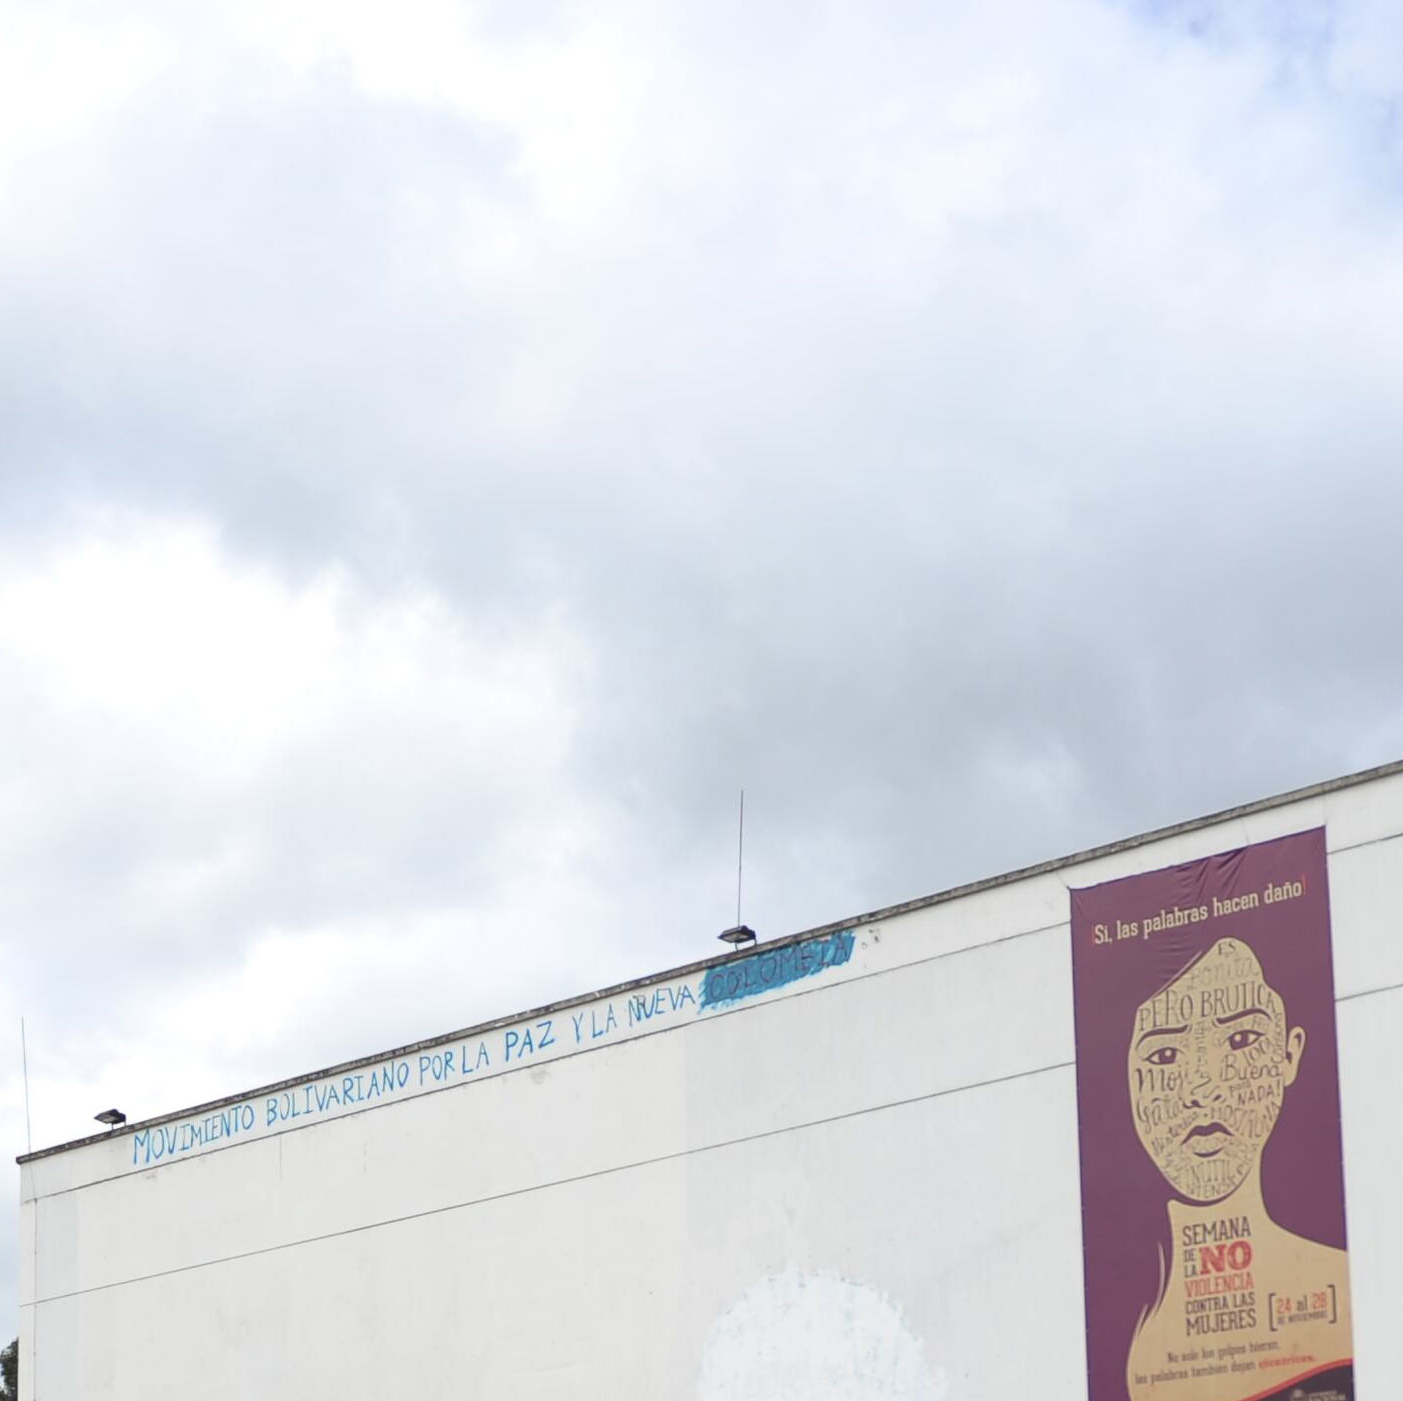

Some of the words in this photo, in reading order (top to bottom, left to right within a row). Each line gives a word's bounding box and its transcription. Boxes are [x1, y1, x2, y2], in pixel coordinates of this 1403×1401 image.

[1116, 920, 1138, 940] las
[1142, 905, 1208, 940] palabras
[1212, 893, 1260, 917] hacen
[1263, 875, 1307, 904] daño!
[1139, 989, 1194, 1031] PERO
[133, 1104, 256, 1164] MOVIMIENTO
[266, 1060, 410, 1126] BOLIVARIANO
[418, 1051, 456, 1086] POR
[461, 1042, 490, 1074] LA
[504, 1020, 556, 1062] PAZ
[572, 1012, 585, 1044] Y
[591, 1003, 618, 1038] LA
[628, 985, 696, 1028] NUEVA
[1182, 1216, 1252, 1247] SEMANA
[1184, 1248, 1196, 1263] DE
[1198, 1240, 1253, 1275] NO
[1184, 1264, 1197, 1279] LA
[1184, 1272, 1254, 1298] VIOLENCIA
[1185, 1296, 1229, 1315] CONTRA
[1233, 1292, 1256, 1309] LAS
[1297, 1294, 1308, 1312] al
[1185, 1308, 1257, 1337] MUJERES
